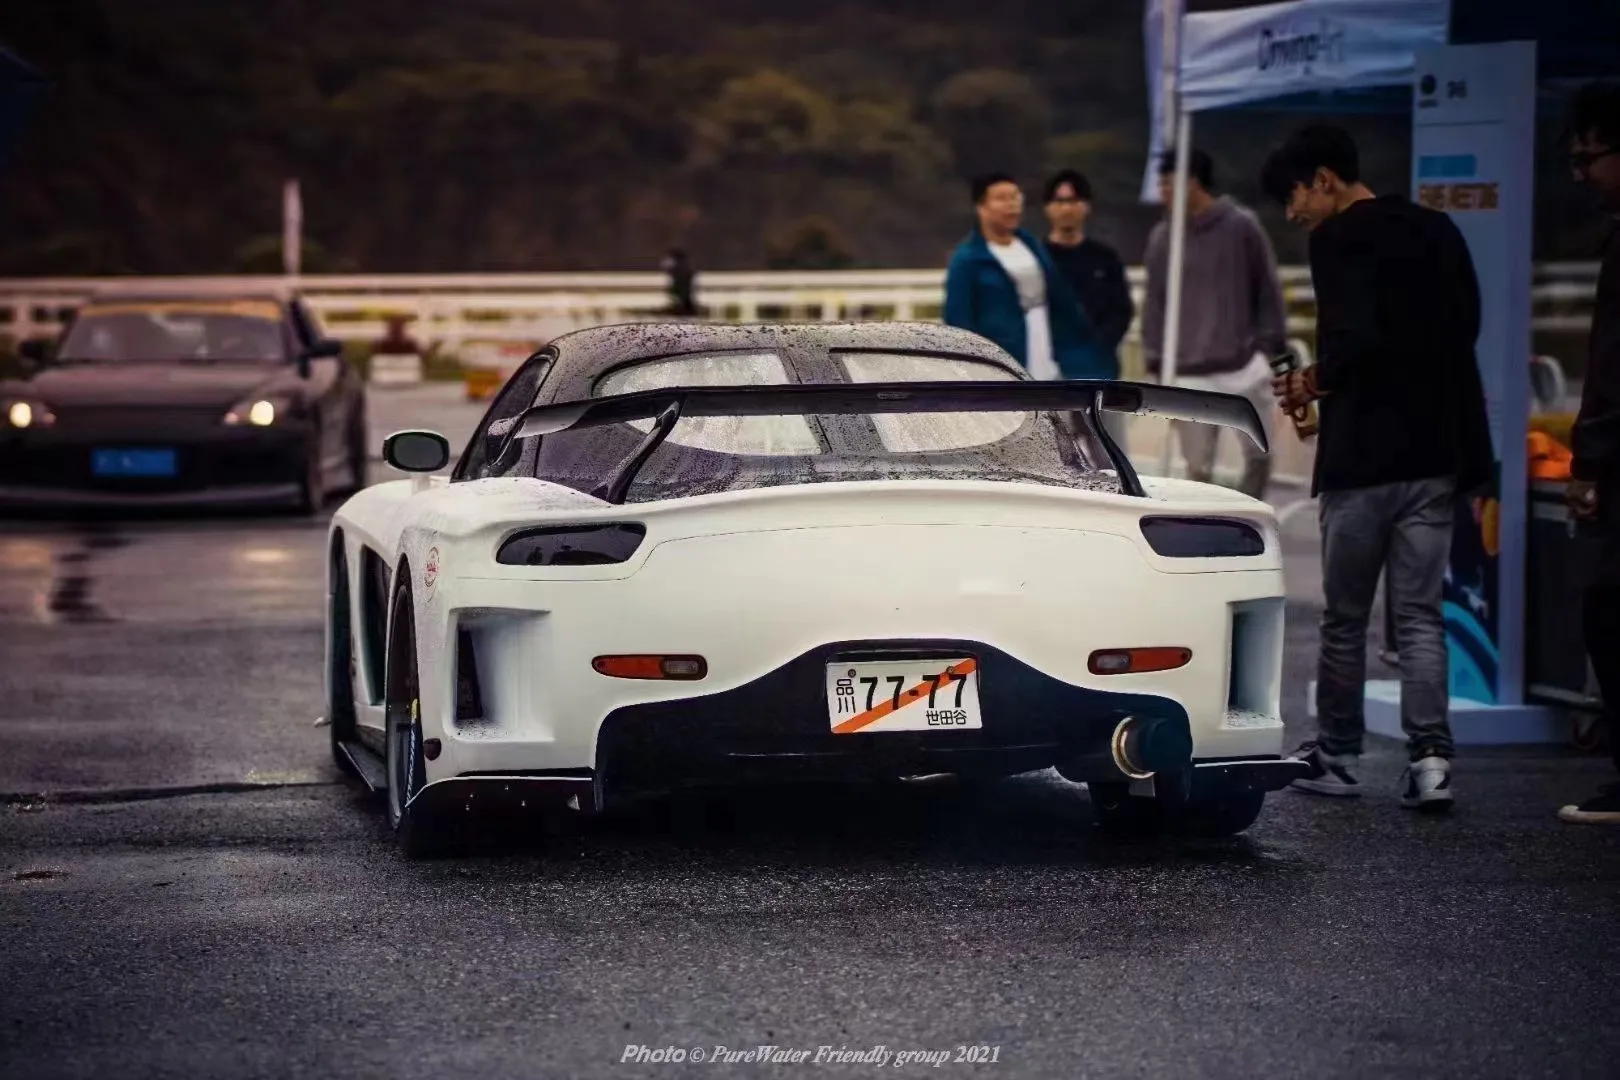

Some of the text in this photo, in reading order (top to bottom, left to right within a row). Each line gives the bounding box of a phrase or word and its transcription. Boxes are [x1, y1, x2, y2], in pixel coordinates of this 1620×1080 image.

[836, 678, 856, 714] 品川
[925, 709, 967, 726] 世田谷
